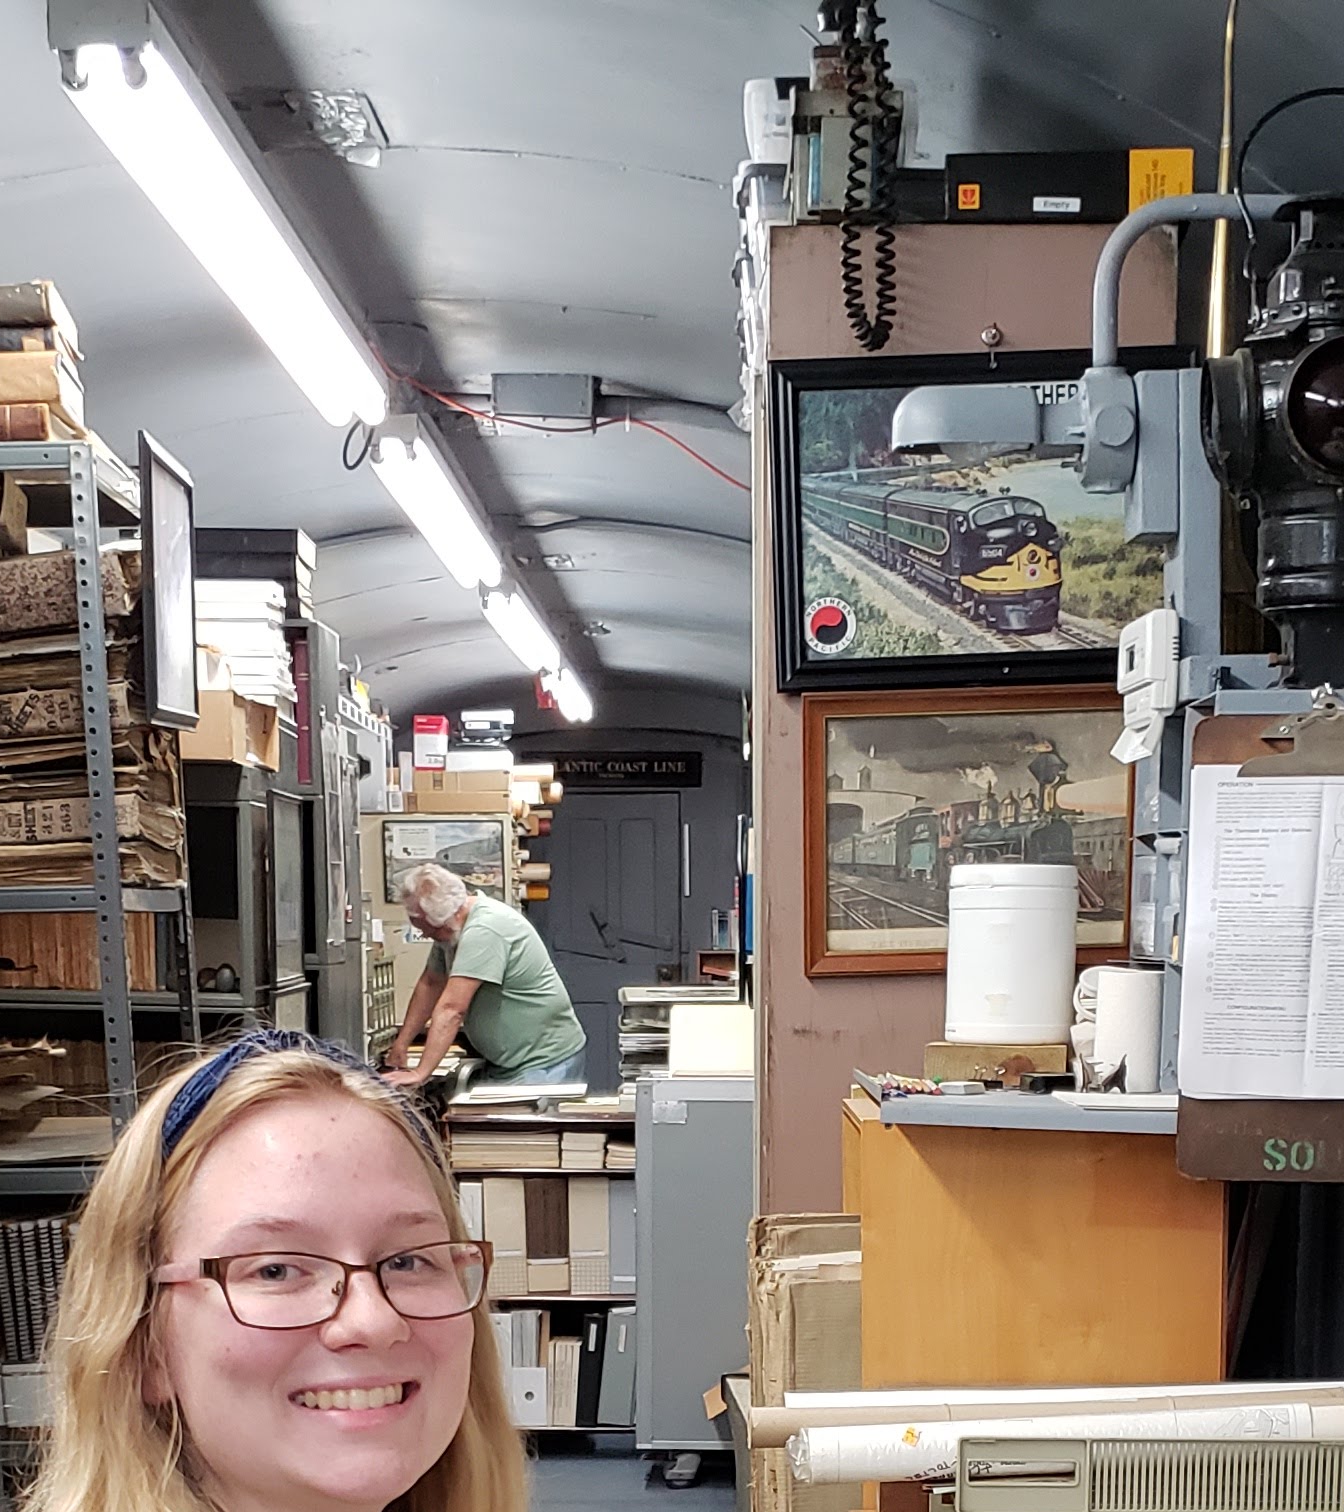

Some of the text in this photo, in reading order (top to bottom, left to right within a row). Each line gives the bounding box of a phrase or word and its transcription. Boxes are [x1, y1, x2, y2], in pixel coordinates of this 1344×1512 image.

[1043, 200, 1070, 209] Empty
[804, 597, 854, 618] NORTHERN
[807, 633, 854, 654] PACIFIC
[607, 761, 648, 773] COAST
[653, 761, 687, 773] LINE
